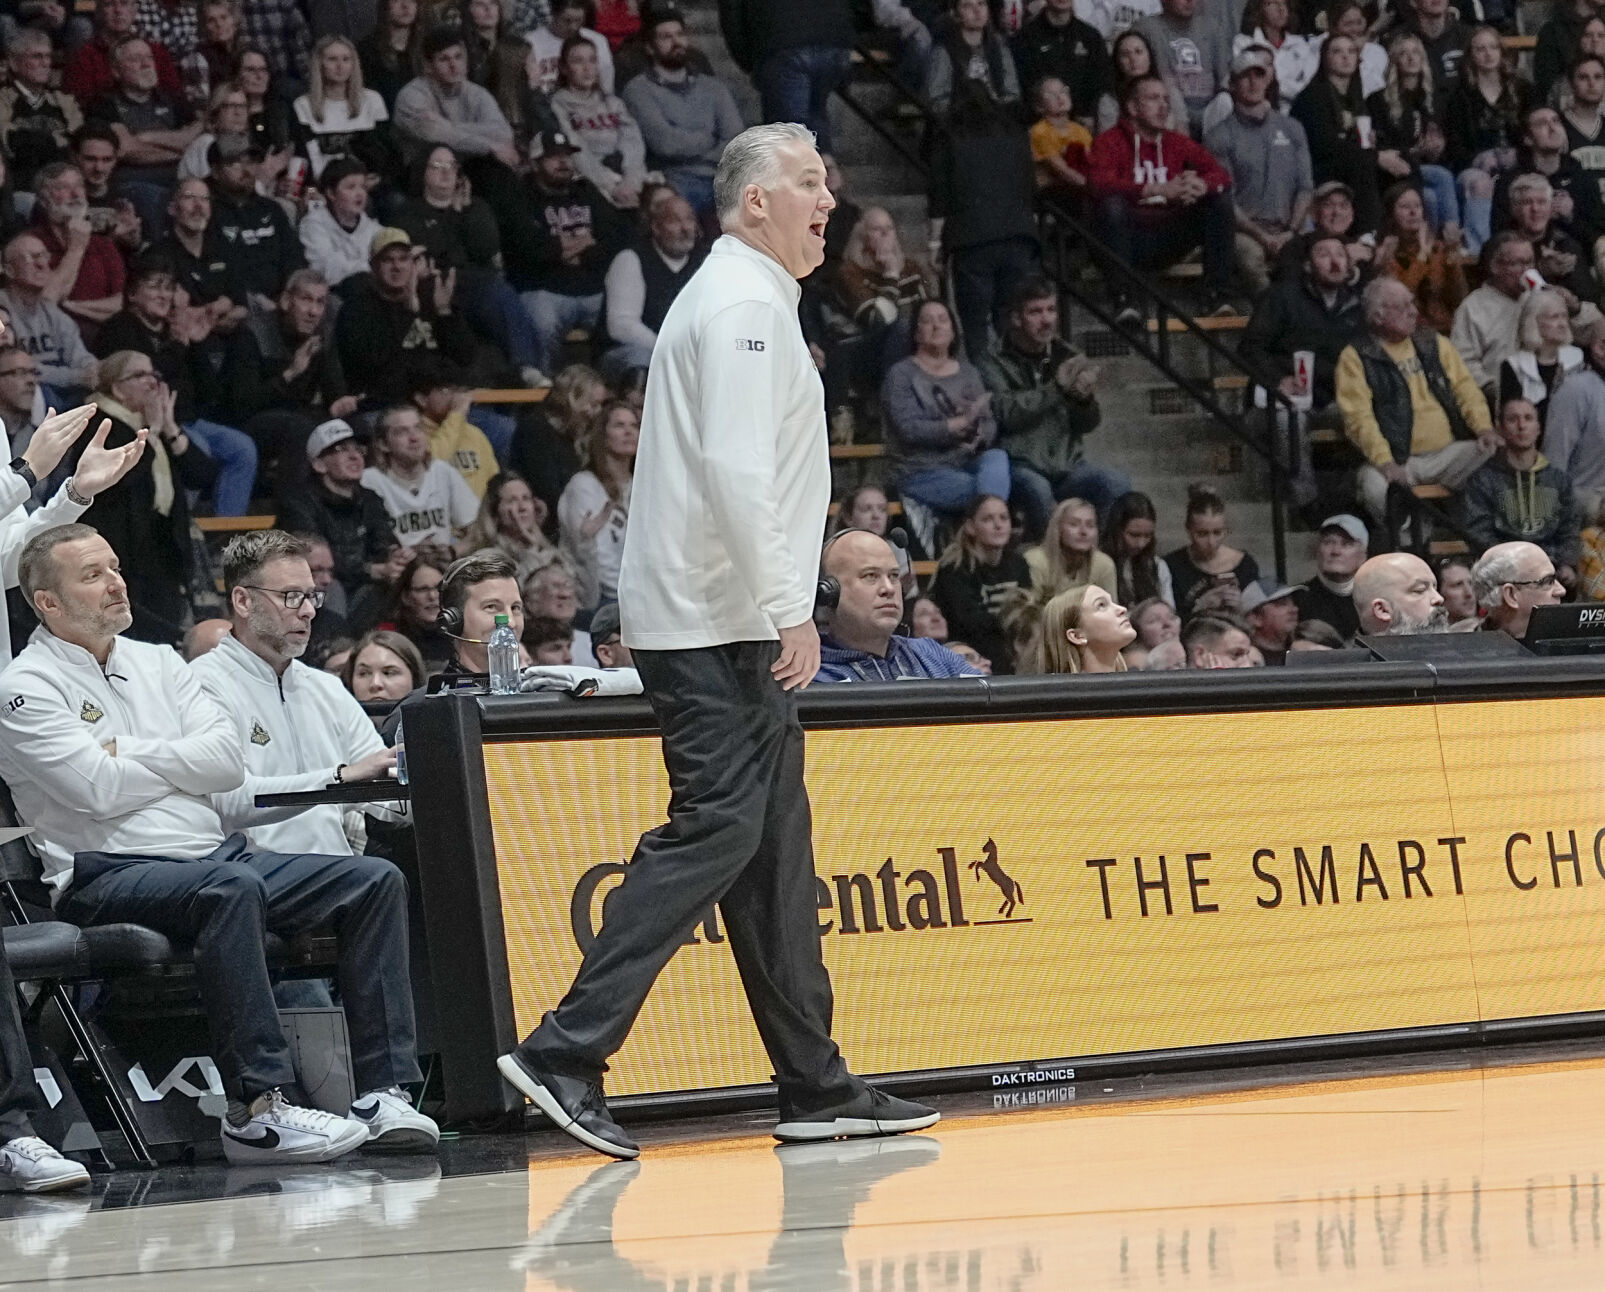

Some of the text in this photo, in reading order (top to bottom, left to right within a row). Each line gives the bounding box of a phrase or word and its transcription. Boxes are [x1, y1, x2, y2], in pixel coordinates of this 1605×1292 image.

[1579, 609, 1605, 621] DVS
[1085, 852, 1219, 919] THE
[1252, 836, 1466, 909] SMART
[992, 1068, 1075, 1085] DAKTRONICS
